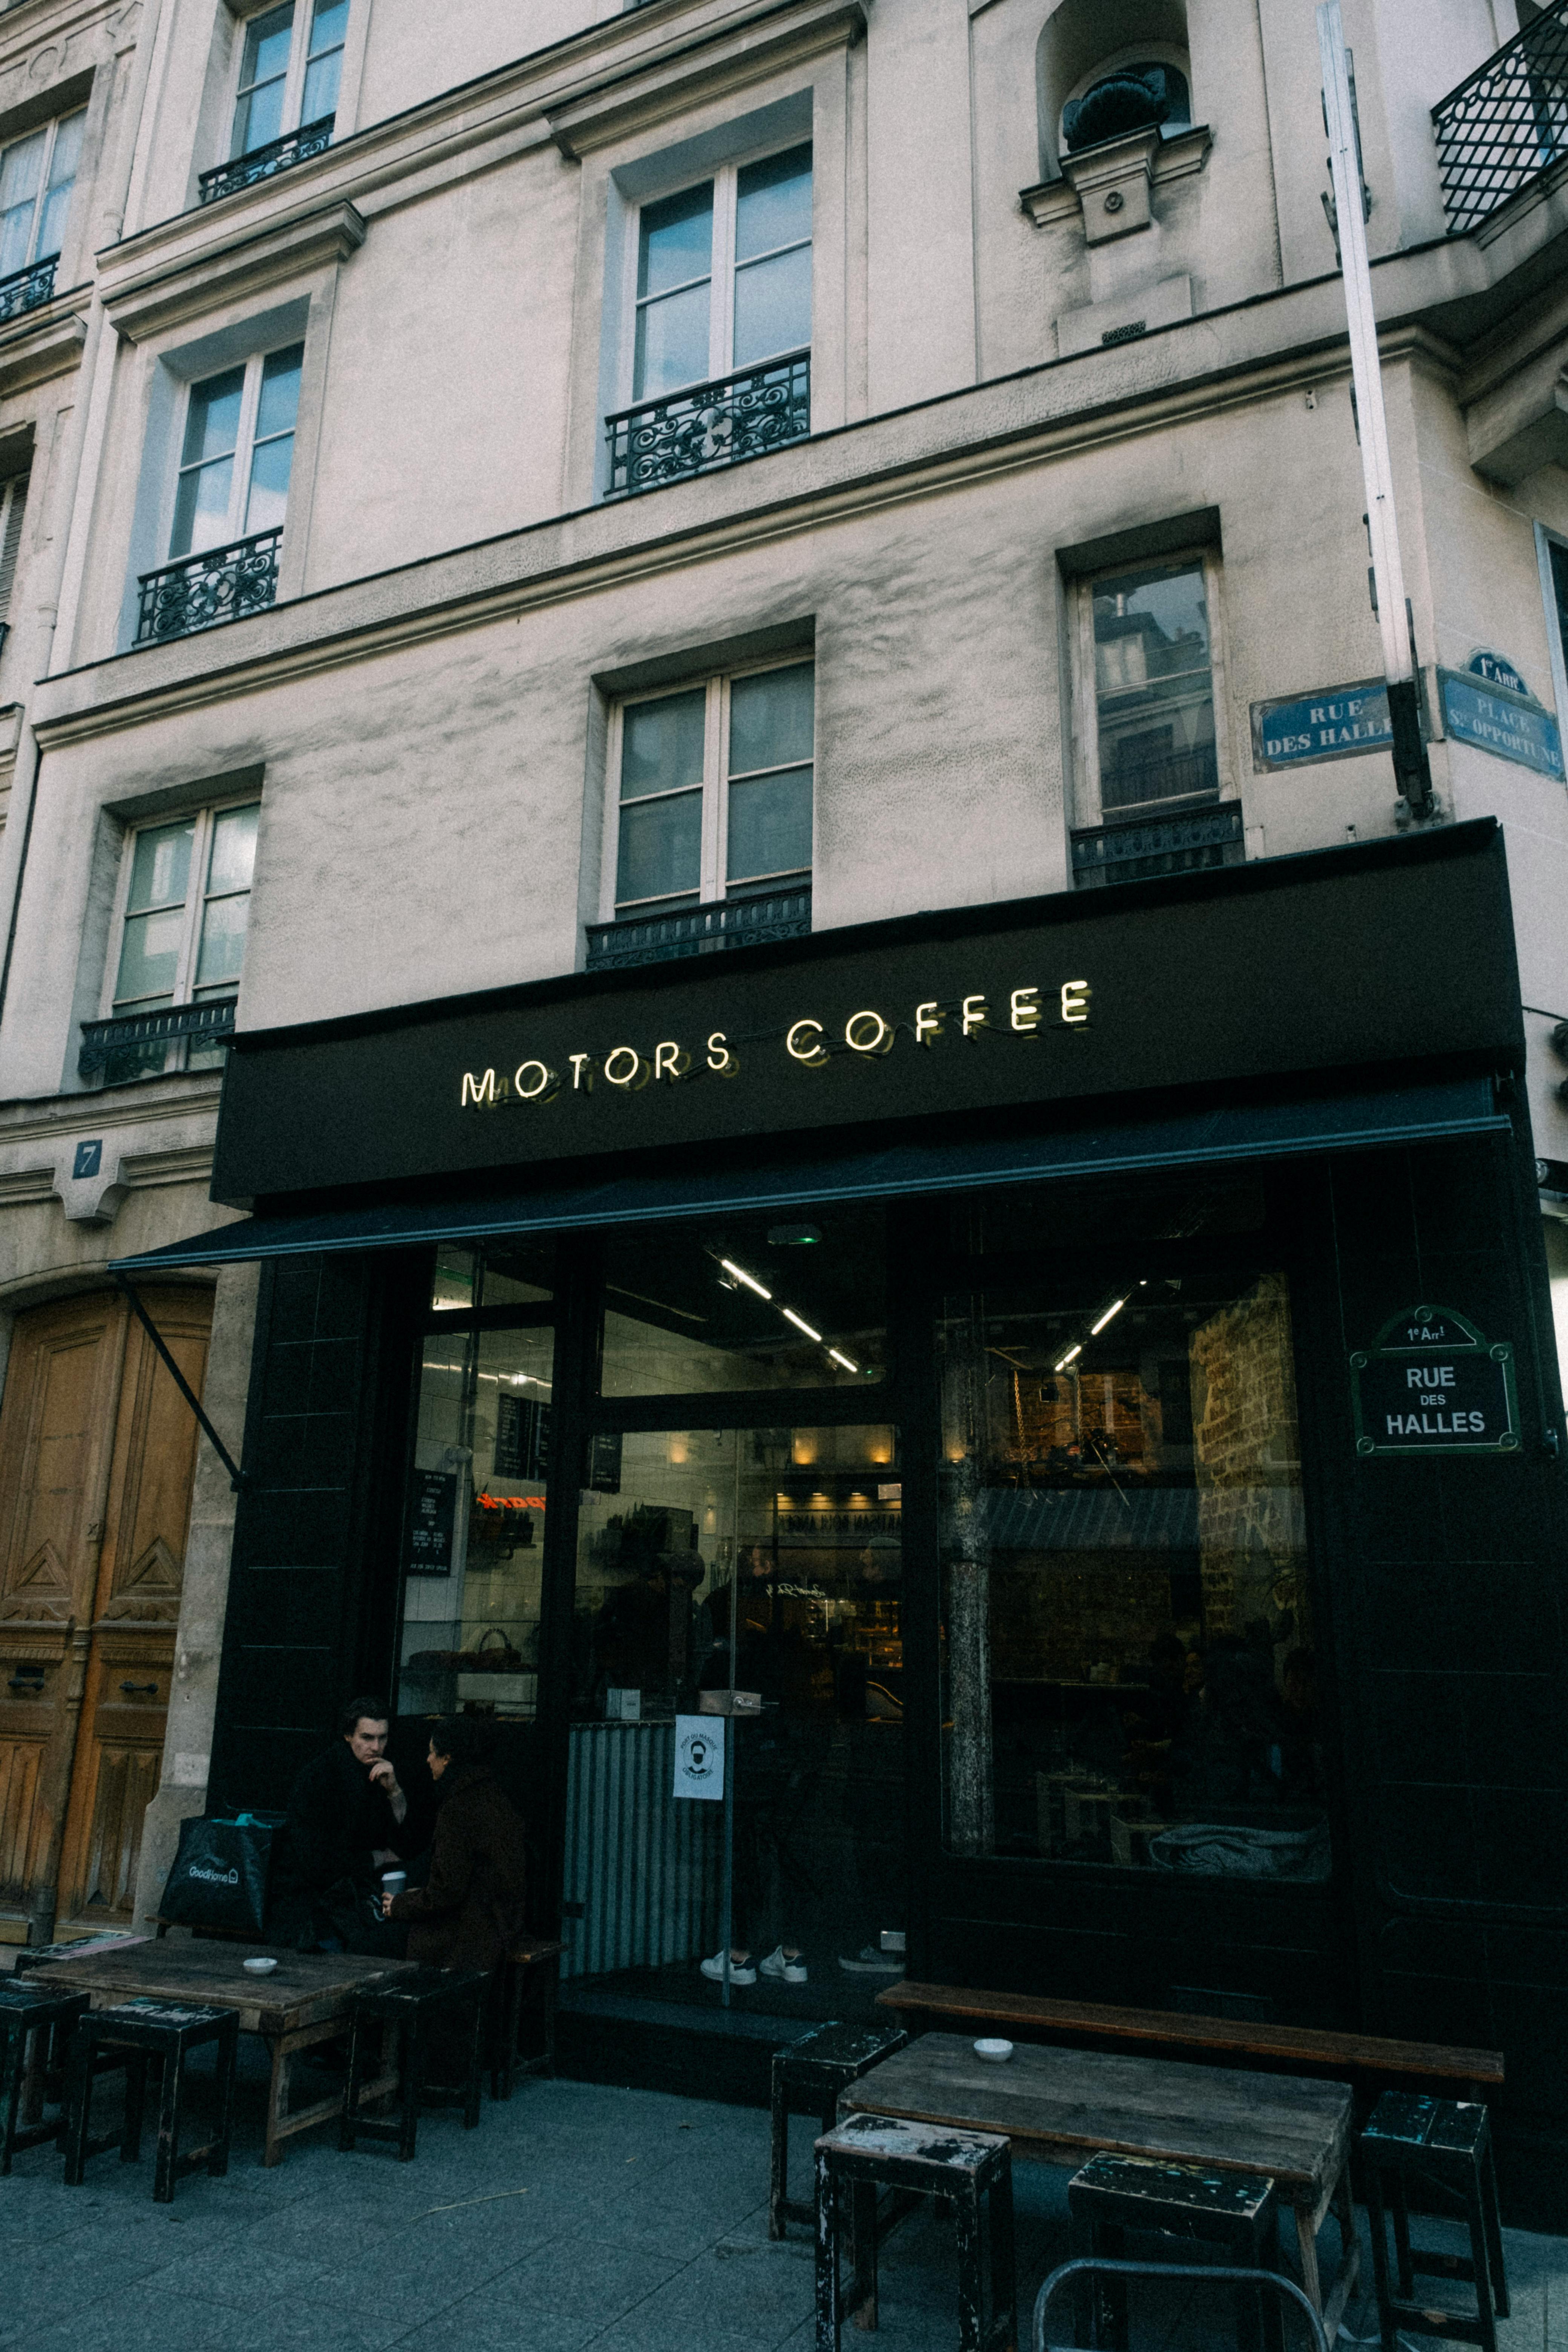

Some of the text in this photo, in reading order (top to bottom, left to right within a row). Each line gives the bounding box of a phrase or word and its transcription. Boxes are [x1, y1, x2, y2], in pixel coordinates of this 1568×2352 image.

[1310, 700, 1363, 724] RUE
[1477, 698, 1530, 732] PLACE
[1267, 718, 1392, 755] DES HALLE
[1473, 719, 1560, 767] OPPORTUNE
[461, 980, 1088, 1107] MOTORS COFFEE
[80, 1146, 96, 1173] 7
[1407, 1366, 1455, 1388] RUE
[1420, 1395, 1446, 1406] DES
[1386, 1412, 1485, 1435] HALLES
[680, 1736, 690, 1749] PORT
[699, 1733, 717, 1750] MASQUE
[683, 1767, 714, 1780] OBLIGATOIRE
[190, 1866, 228, 1883] GoodHome
